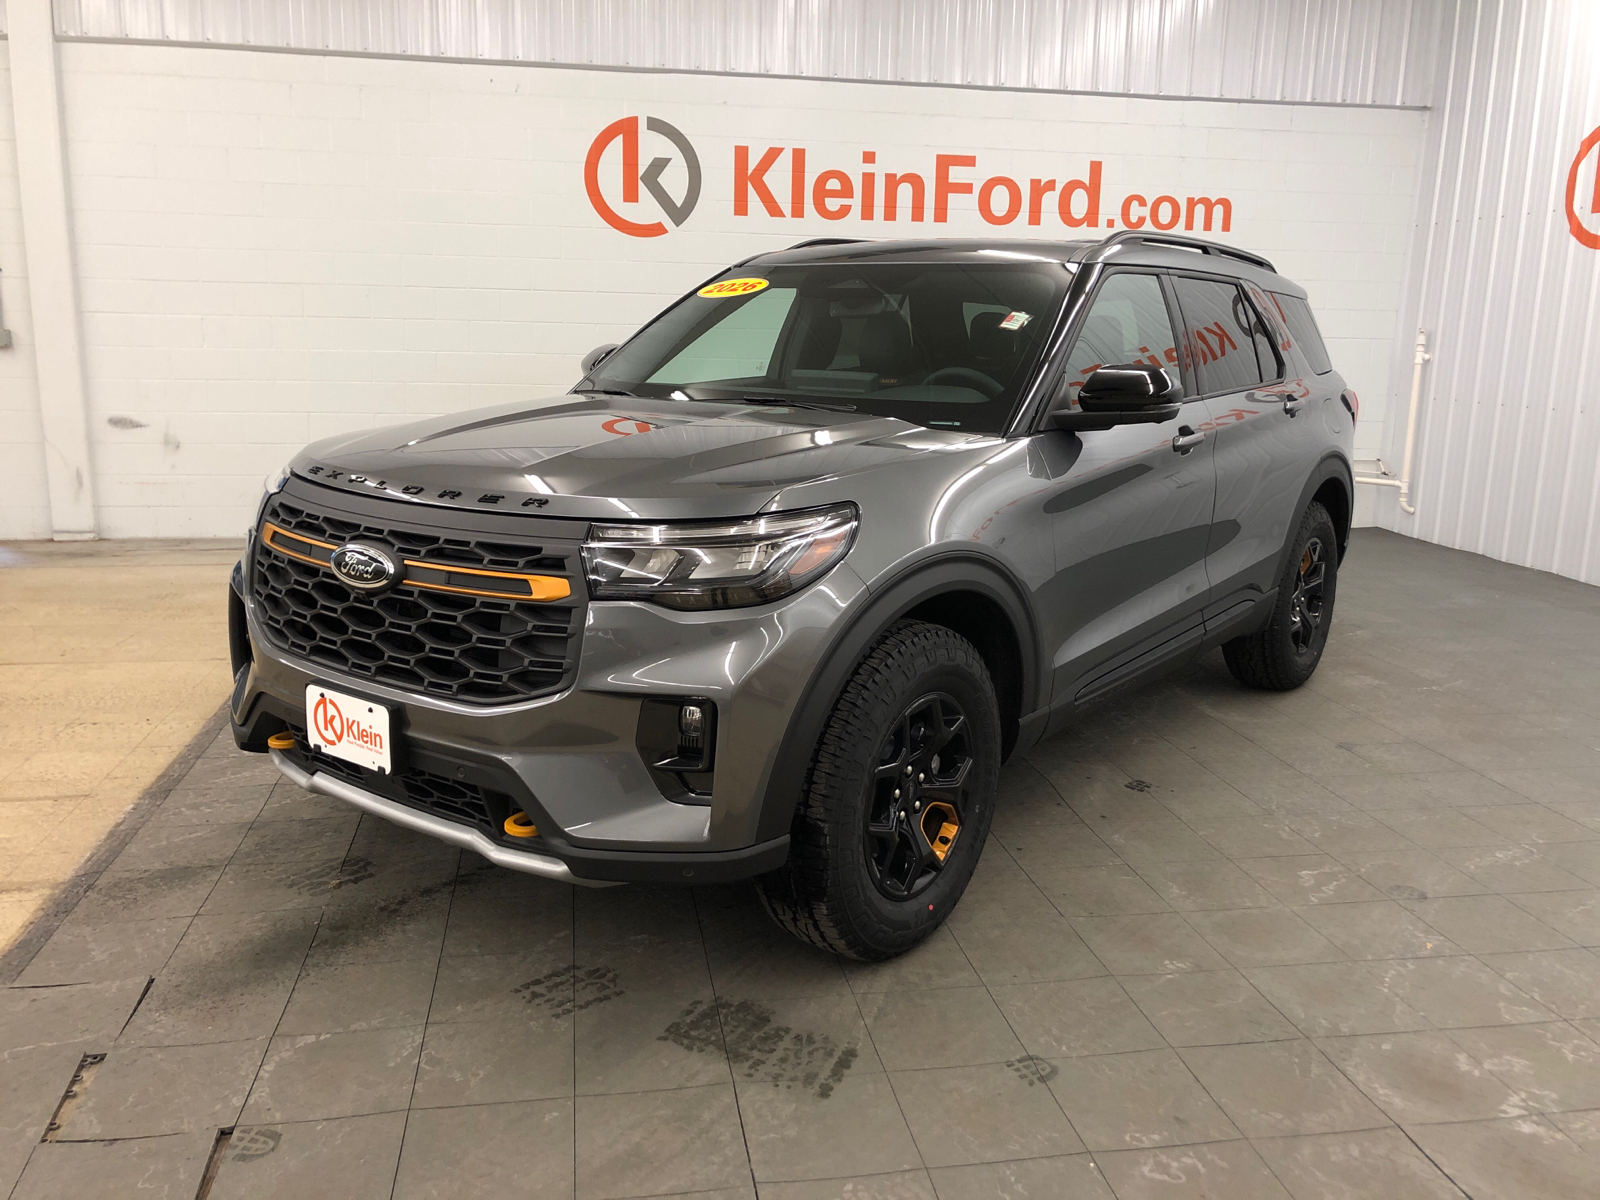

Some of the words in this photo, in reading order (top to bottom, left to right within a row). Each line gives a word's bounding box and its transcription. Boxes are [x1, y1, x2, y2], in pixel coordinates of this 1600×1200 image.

[733, 145, 1233, 233] KleinFord.com
[703, 281, 763, 294] 2026
[307, 465, 551, 509] EXPLORER
[340, 551, 376, 580] Ford
[346, 717, 383, 749] Klein
